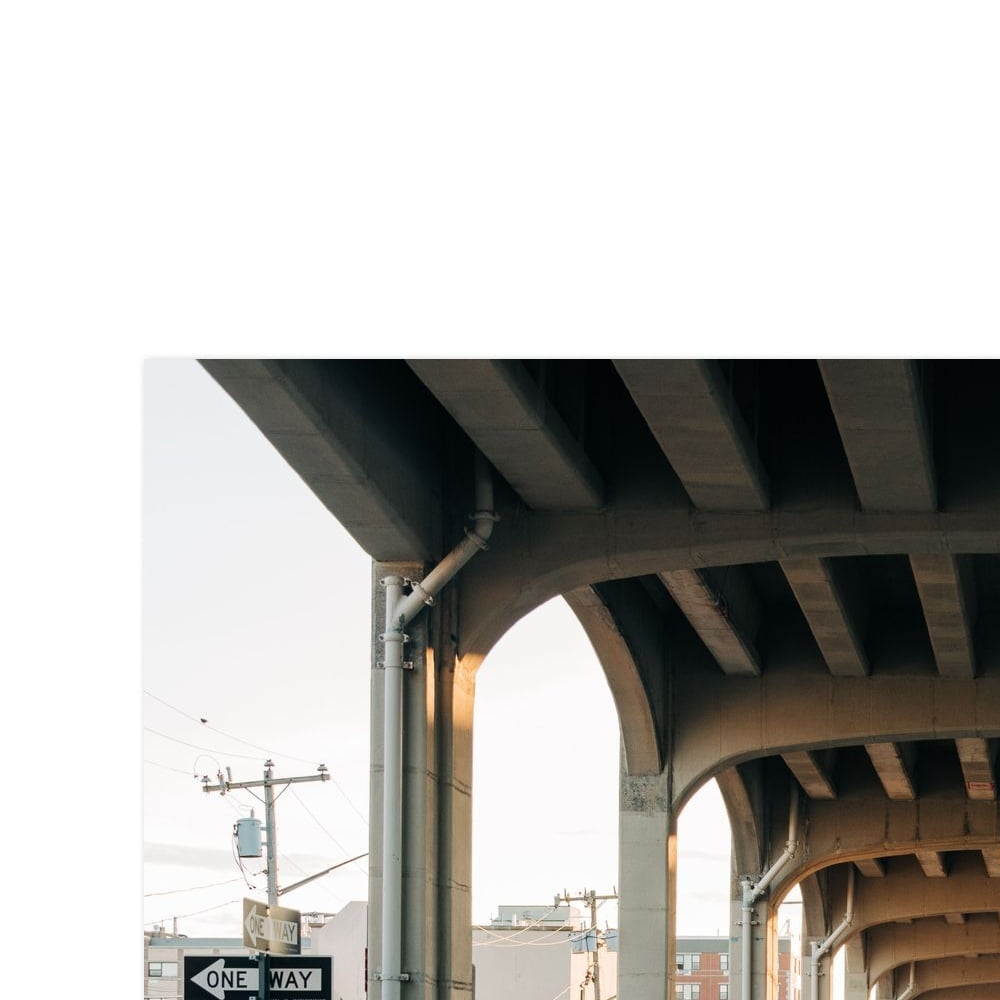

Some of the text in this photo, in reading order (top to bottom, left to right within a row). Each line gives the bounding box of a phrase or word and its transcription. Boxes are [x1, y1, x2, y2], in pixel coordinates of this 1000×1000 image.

[250, 916, 296, 943] ONE WAY
[207, 970, 312, 989] ONE WAY
